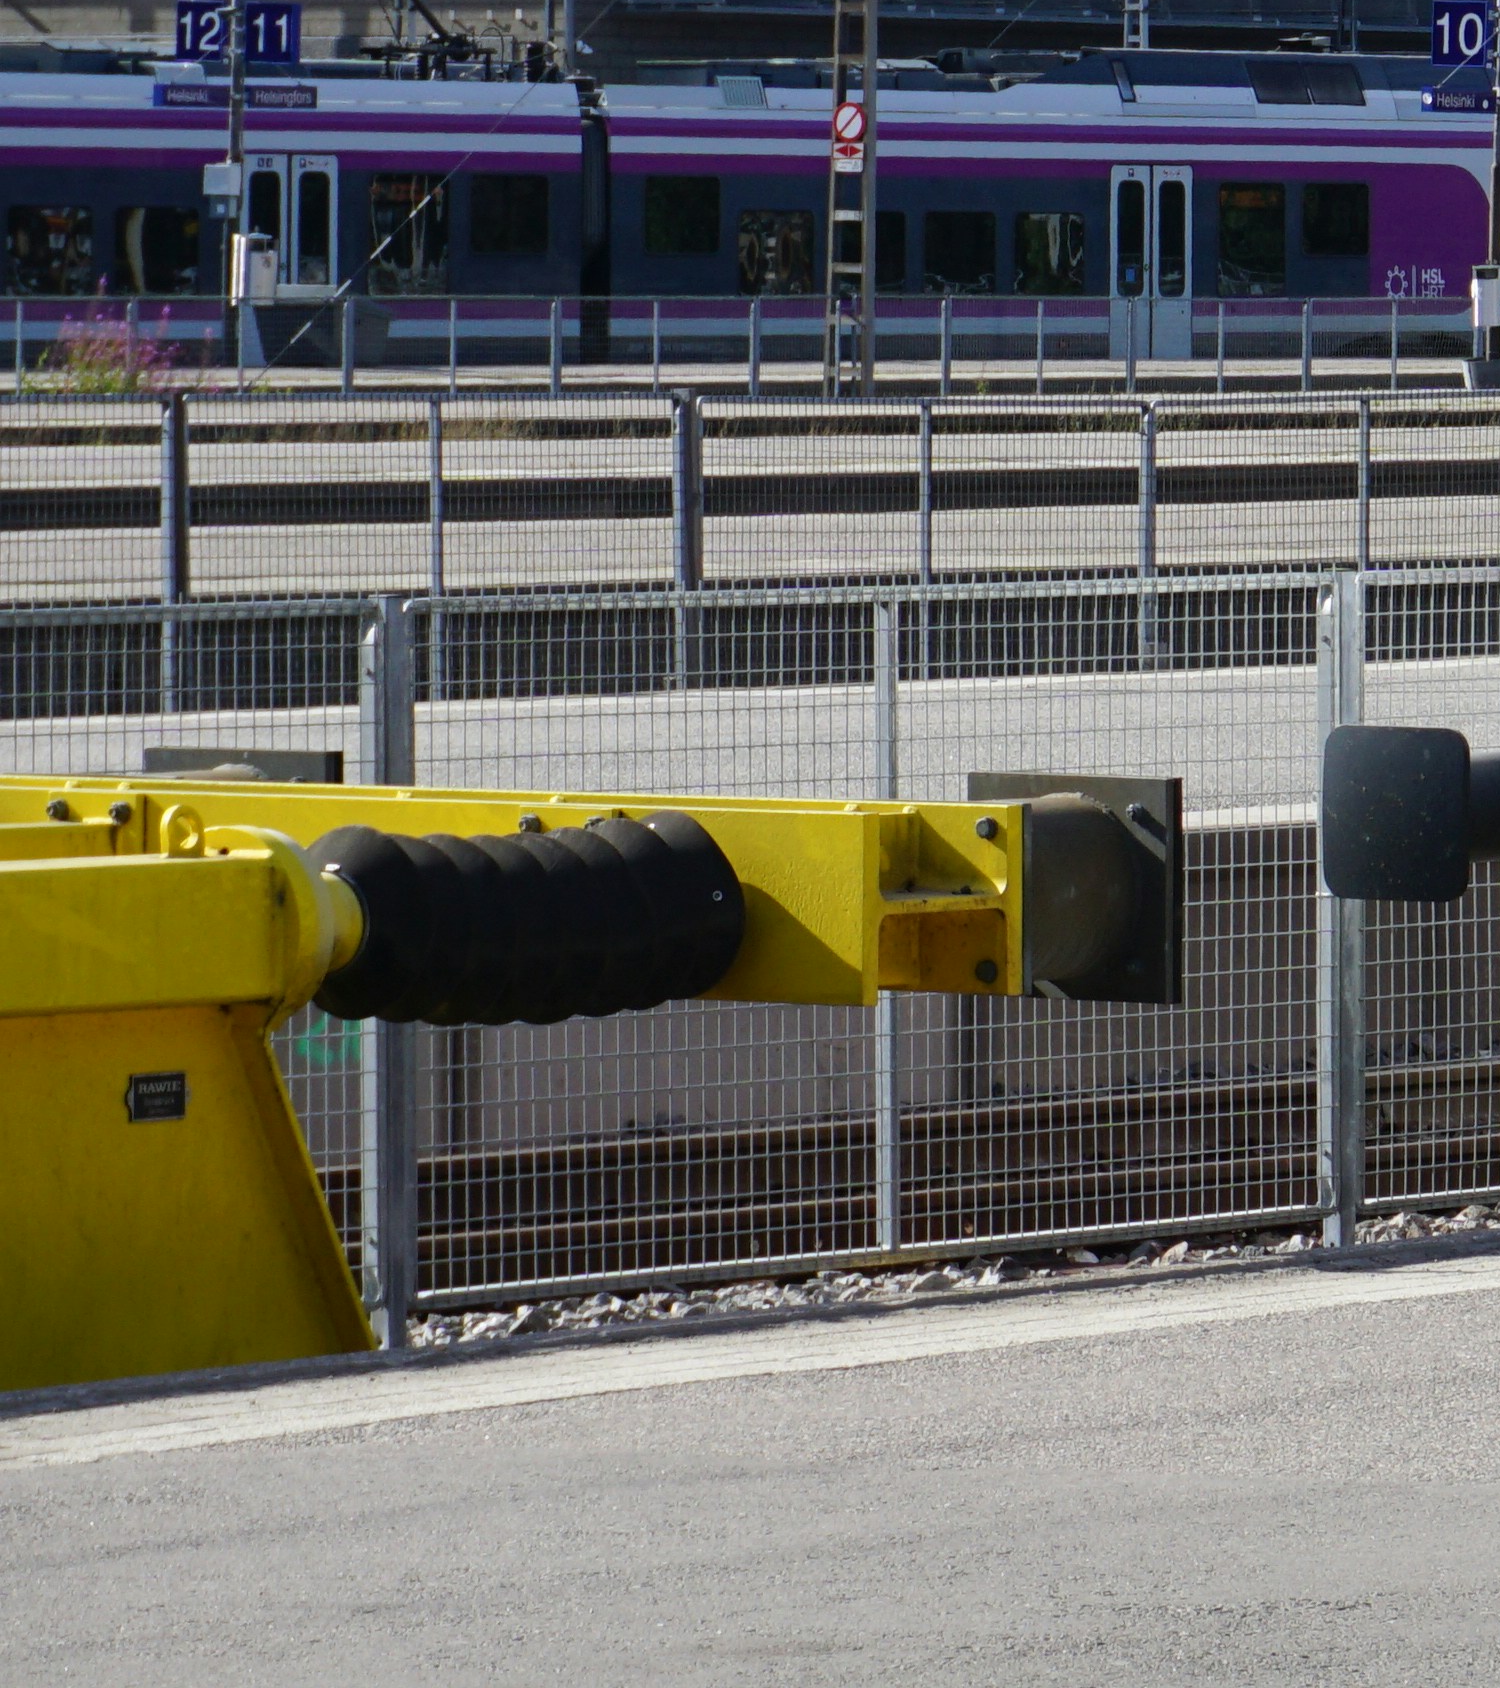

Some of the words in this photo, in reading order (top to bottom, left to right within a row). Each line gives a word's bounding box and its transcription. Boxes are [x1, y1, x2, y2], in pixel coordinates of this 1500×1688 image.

[180, 11, 221, 51] 12
[253, 13, 289, 53] 11
[1436, 12, 1483, 56] 10
[167, 86, 208, 103] Helsinki
[255, 89, 312, 107] Helsingfors
[1437, 93, 1475, 108] Helsinki
[1421, 268, 1445, 284] HSL
